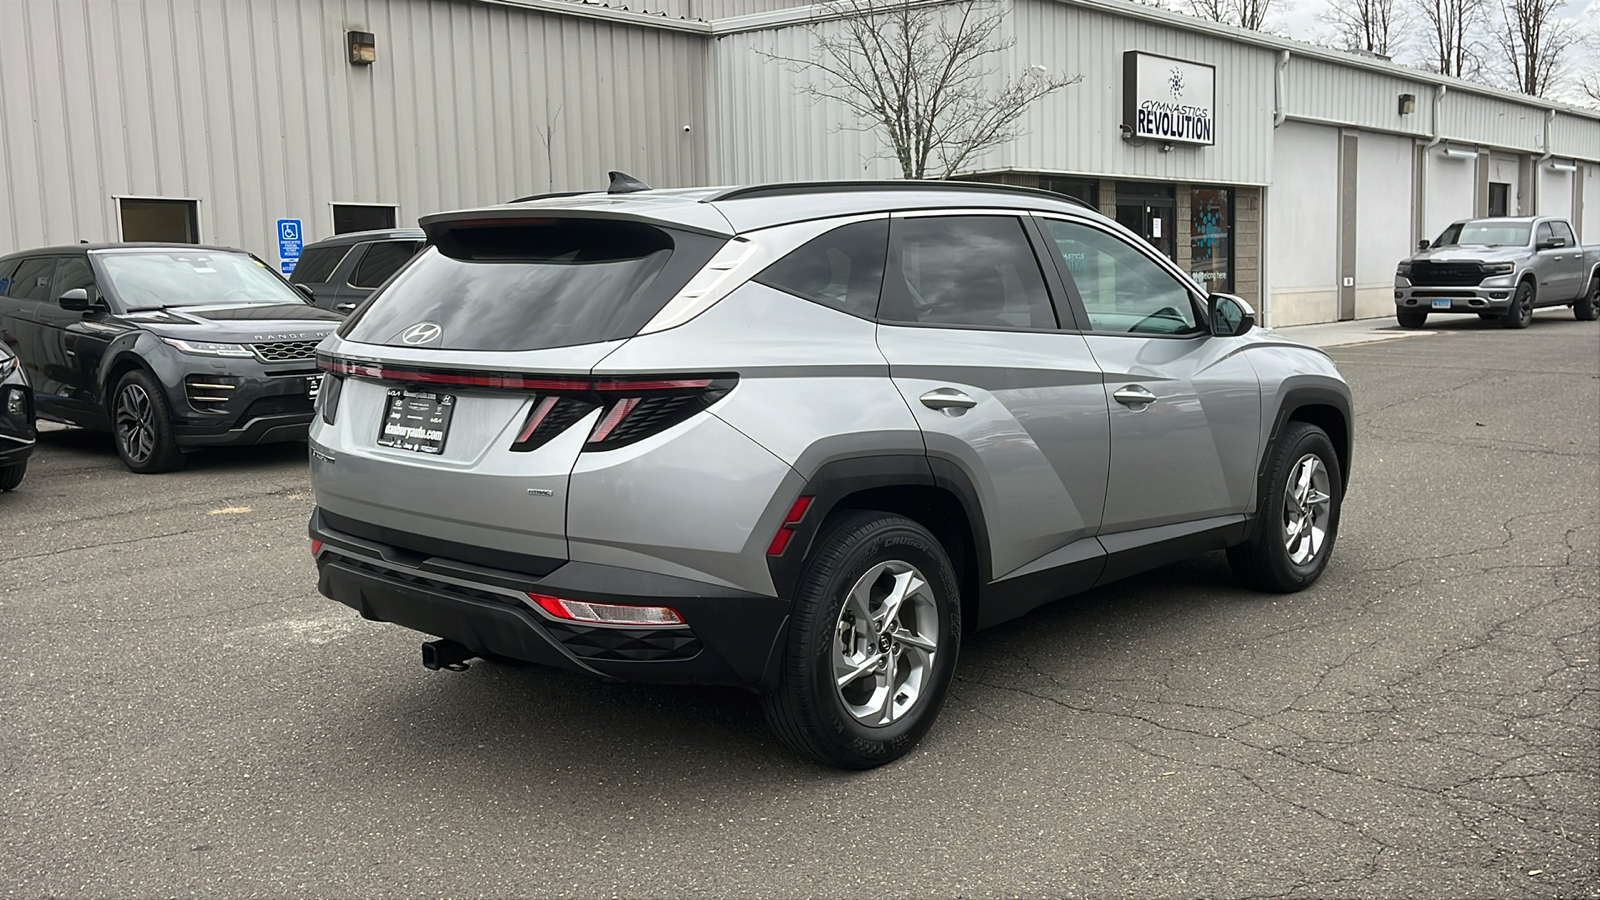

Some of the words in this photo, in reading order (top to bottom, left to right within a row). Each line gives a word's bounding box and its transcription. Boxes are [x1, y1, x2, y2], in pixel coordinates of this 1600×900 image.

[1141, 100, 1208, 118] GYMNASTICS
[1138, 108, 1211, 141] REVOLUTION
[385, 422, 443, 441] danburyauto.com
[884, 536, 929, 552] CRUGEN
